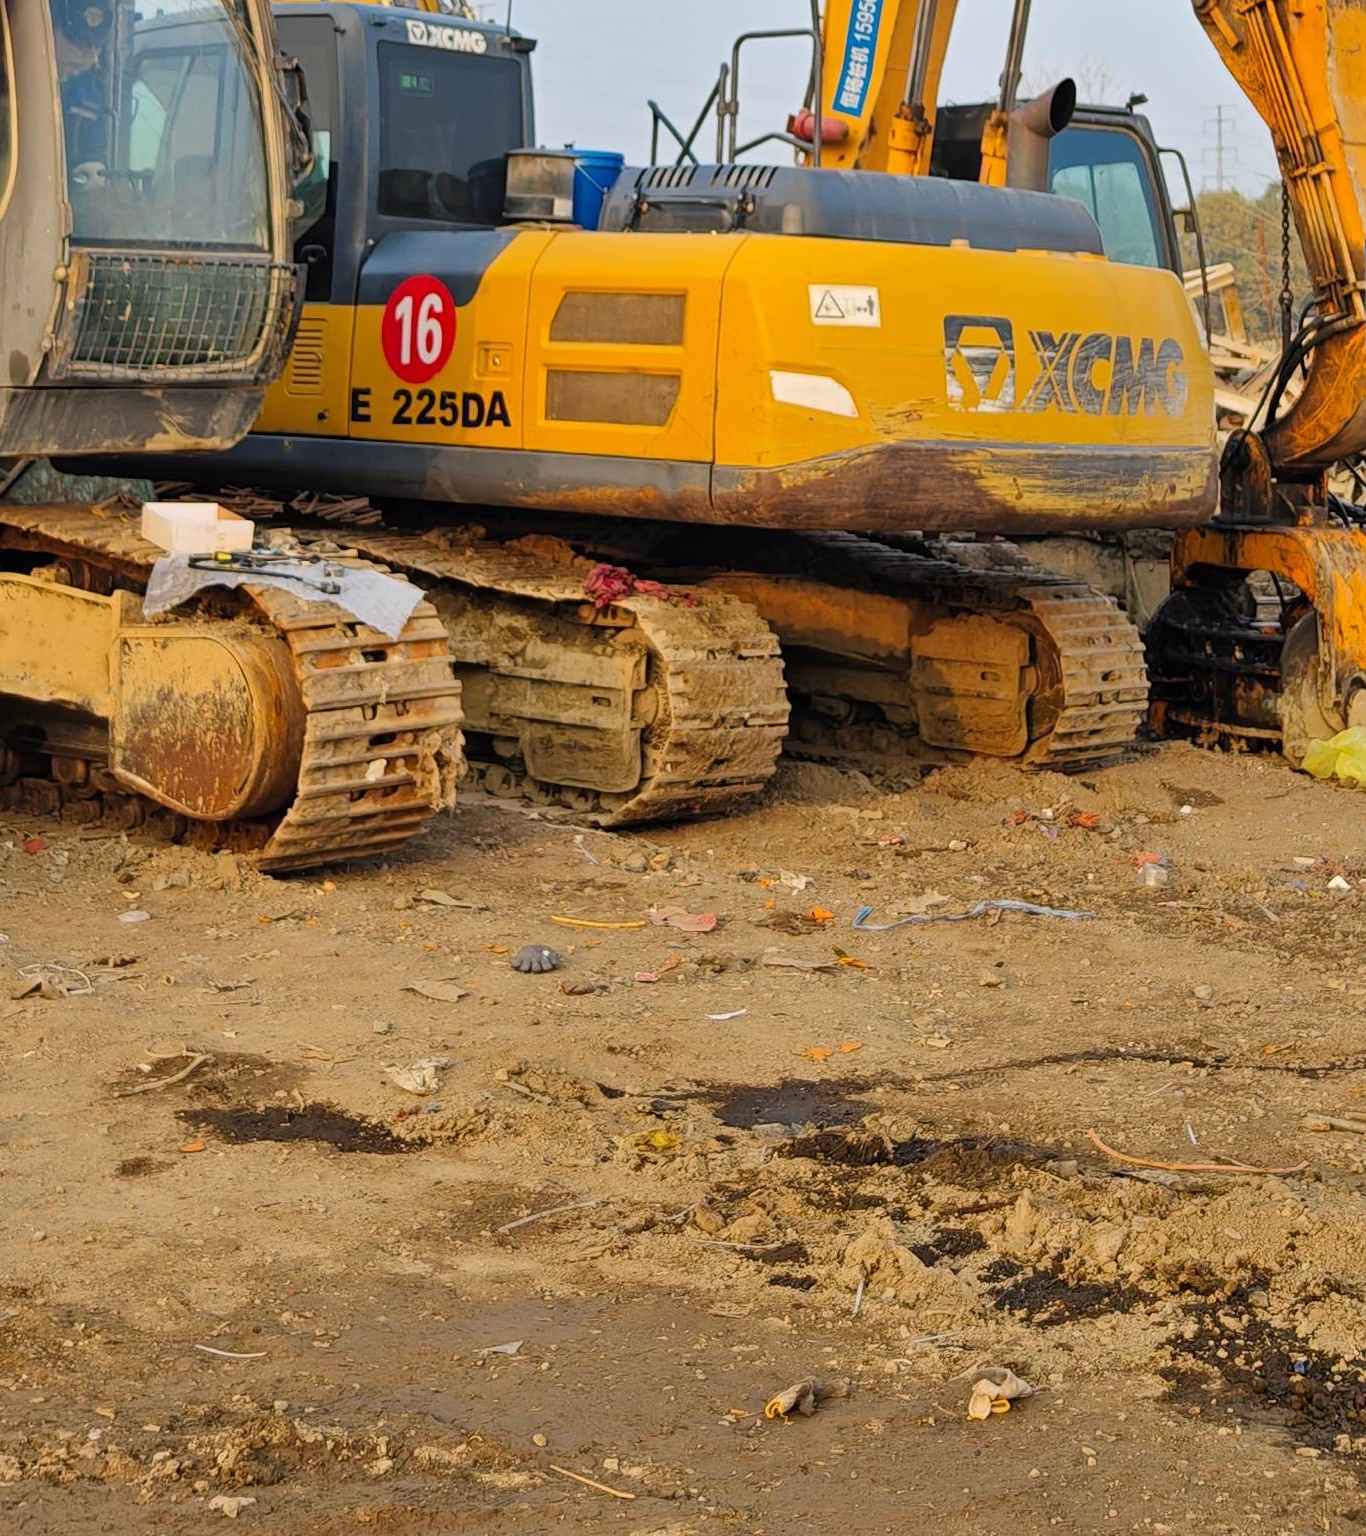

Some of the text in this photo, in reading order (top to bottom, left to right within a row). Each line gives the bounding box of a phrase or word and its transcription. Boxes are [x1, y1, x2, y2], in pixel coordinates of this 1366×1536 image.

[427, 24, 487, 54] XCMG
[395, 293, 443, 365] 16
[1019, 330, 1188, 416] XCMG
[392, 389, 511, 427] 225DA
